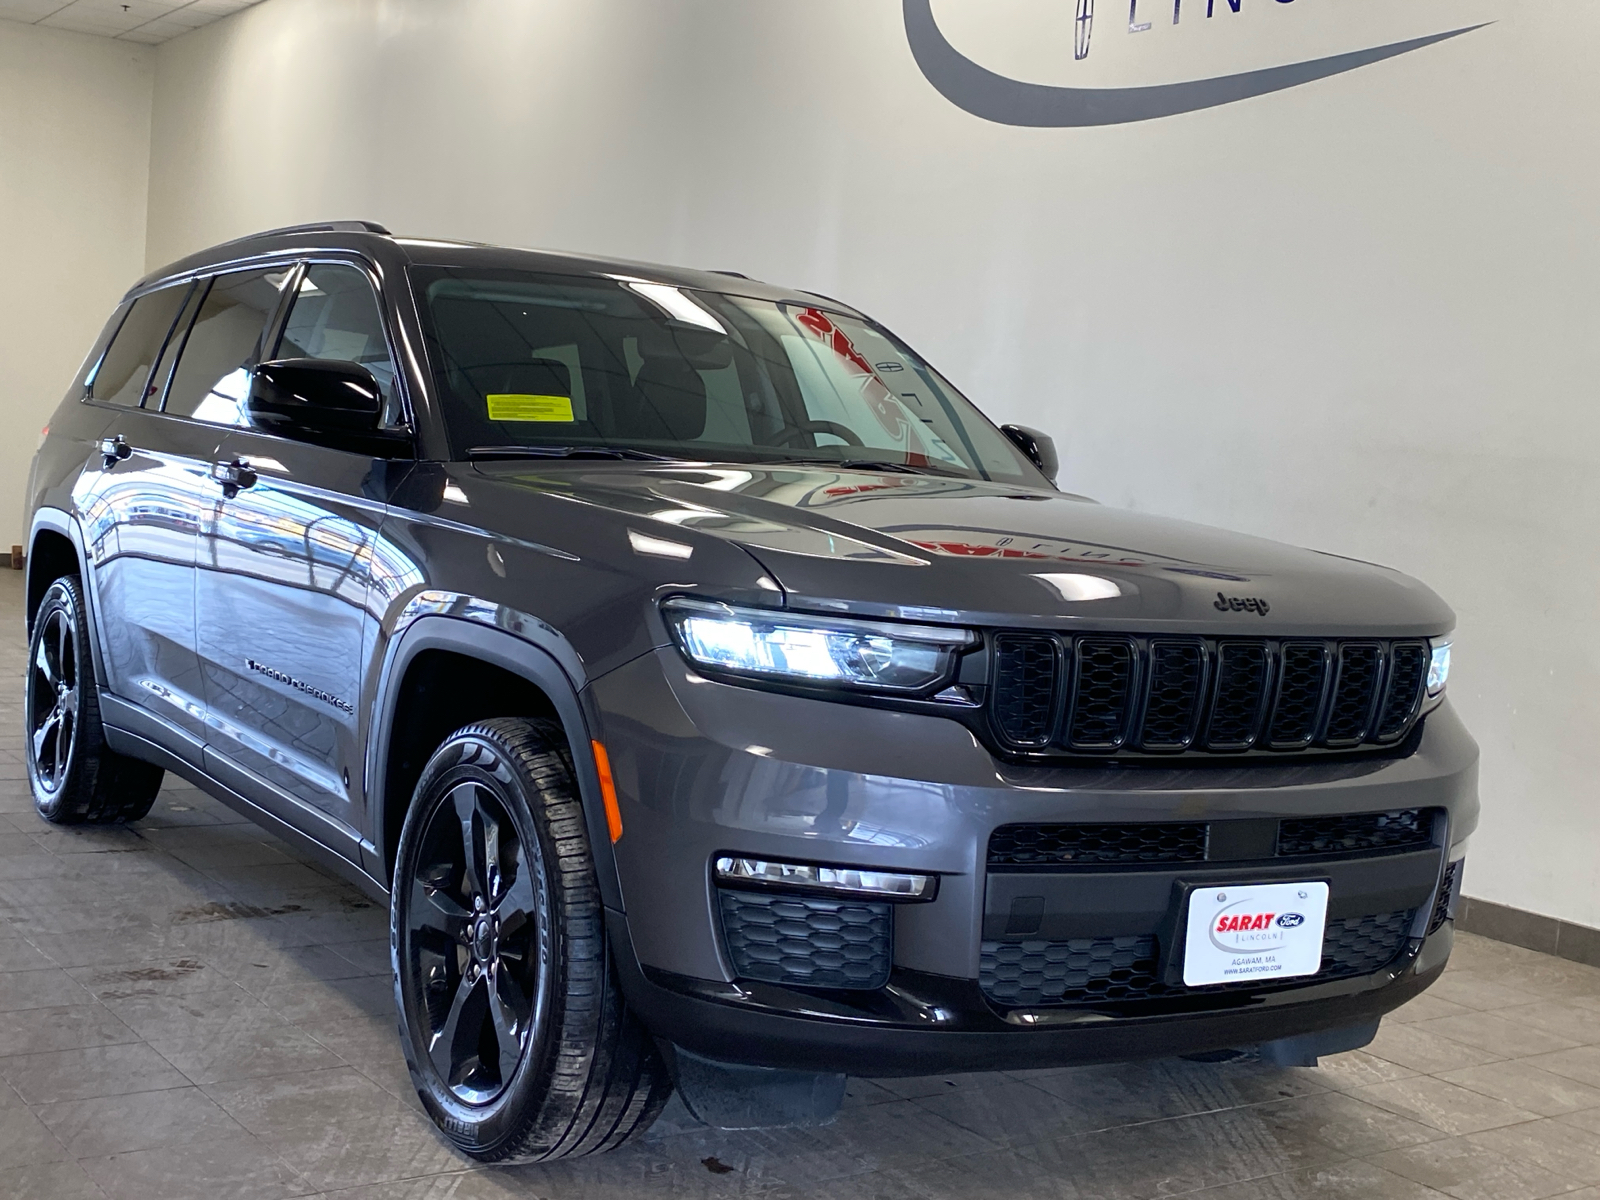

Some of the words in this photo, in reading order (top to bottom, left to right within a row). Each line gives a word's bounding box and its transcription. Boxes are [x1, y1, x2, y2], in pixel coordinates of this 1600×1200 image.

[1213, 591, 1271, 617] Jeep
[254, 662, 292, 685] GRAND
[291, 678, 354, 715] CHEROKEE
[1217, 913, 1275, 933] SARAT
[1279, 914, 1301, 927] Ford
[1241, 933, 1278, 942] LINCOLN
[1231, 957, 1263, 966] AGAWAM,
[1265, 955, 1276, 964] MA
[1224, 966, 1282, 975] WWW.SARATFORD.COM
